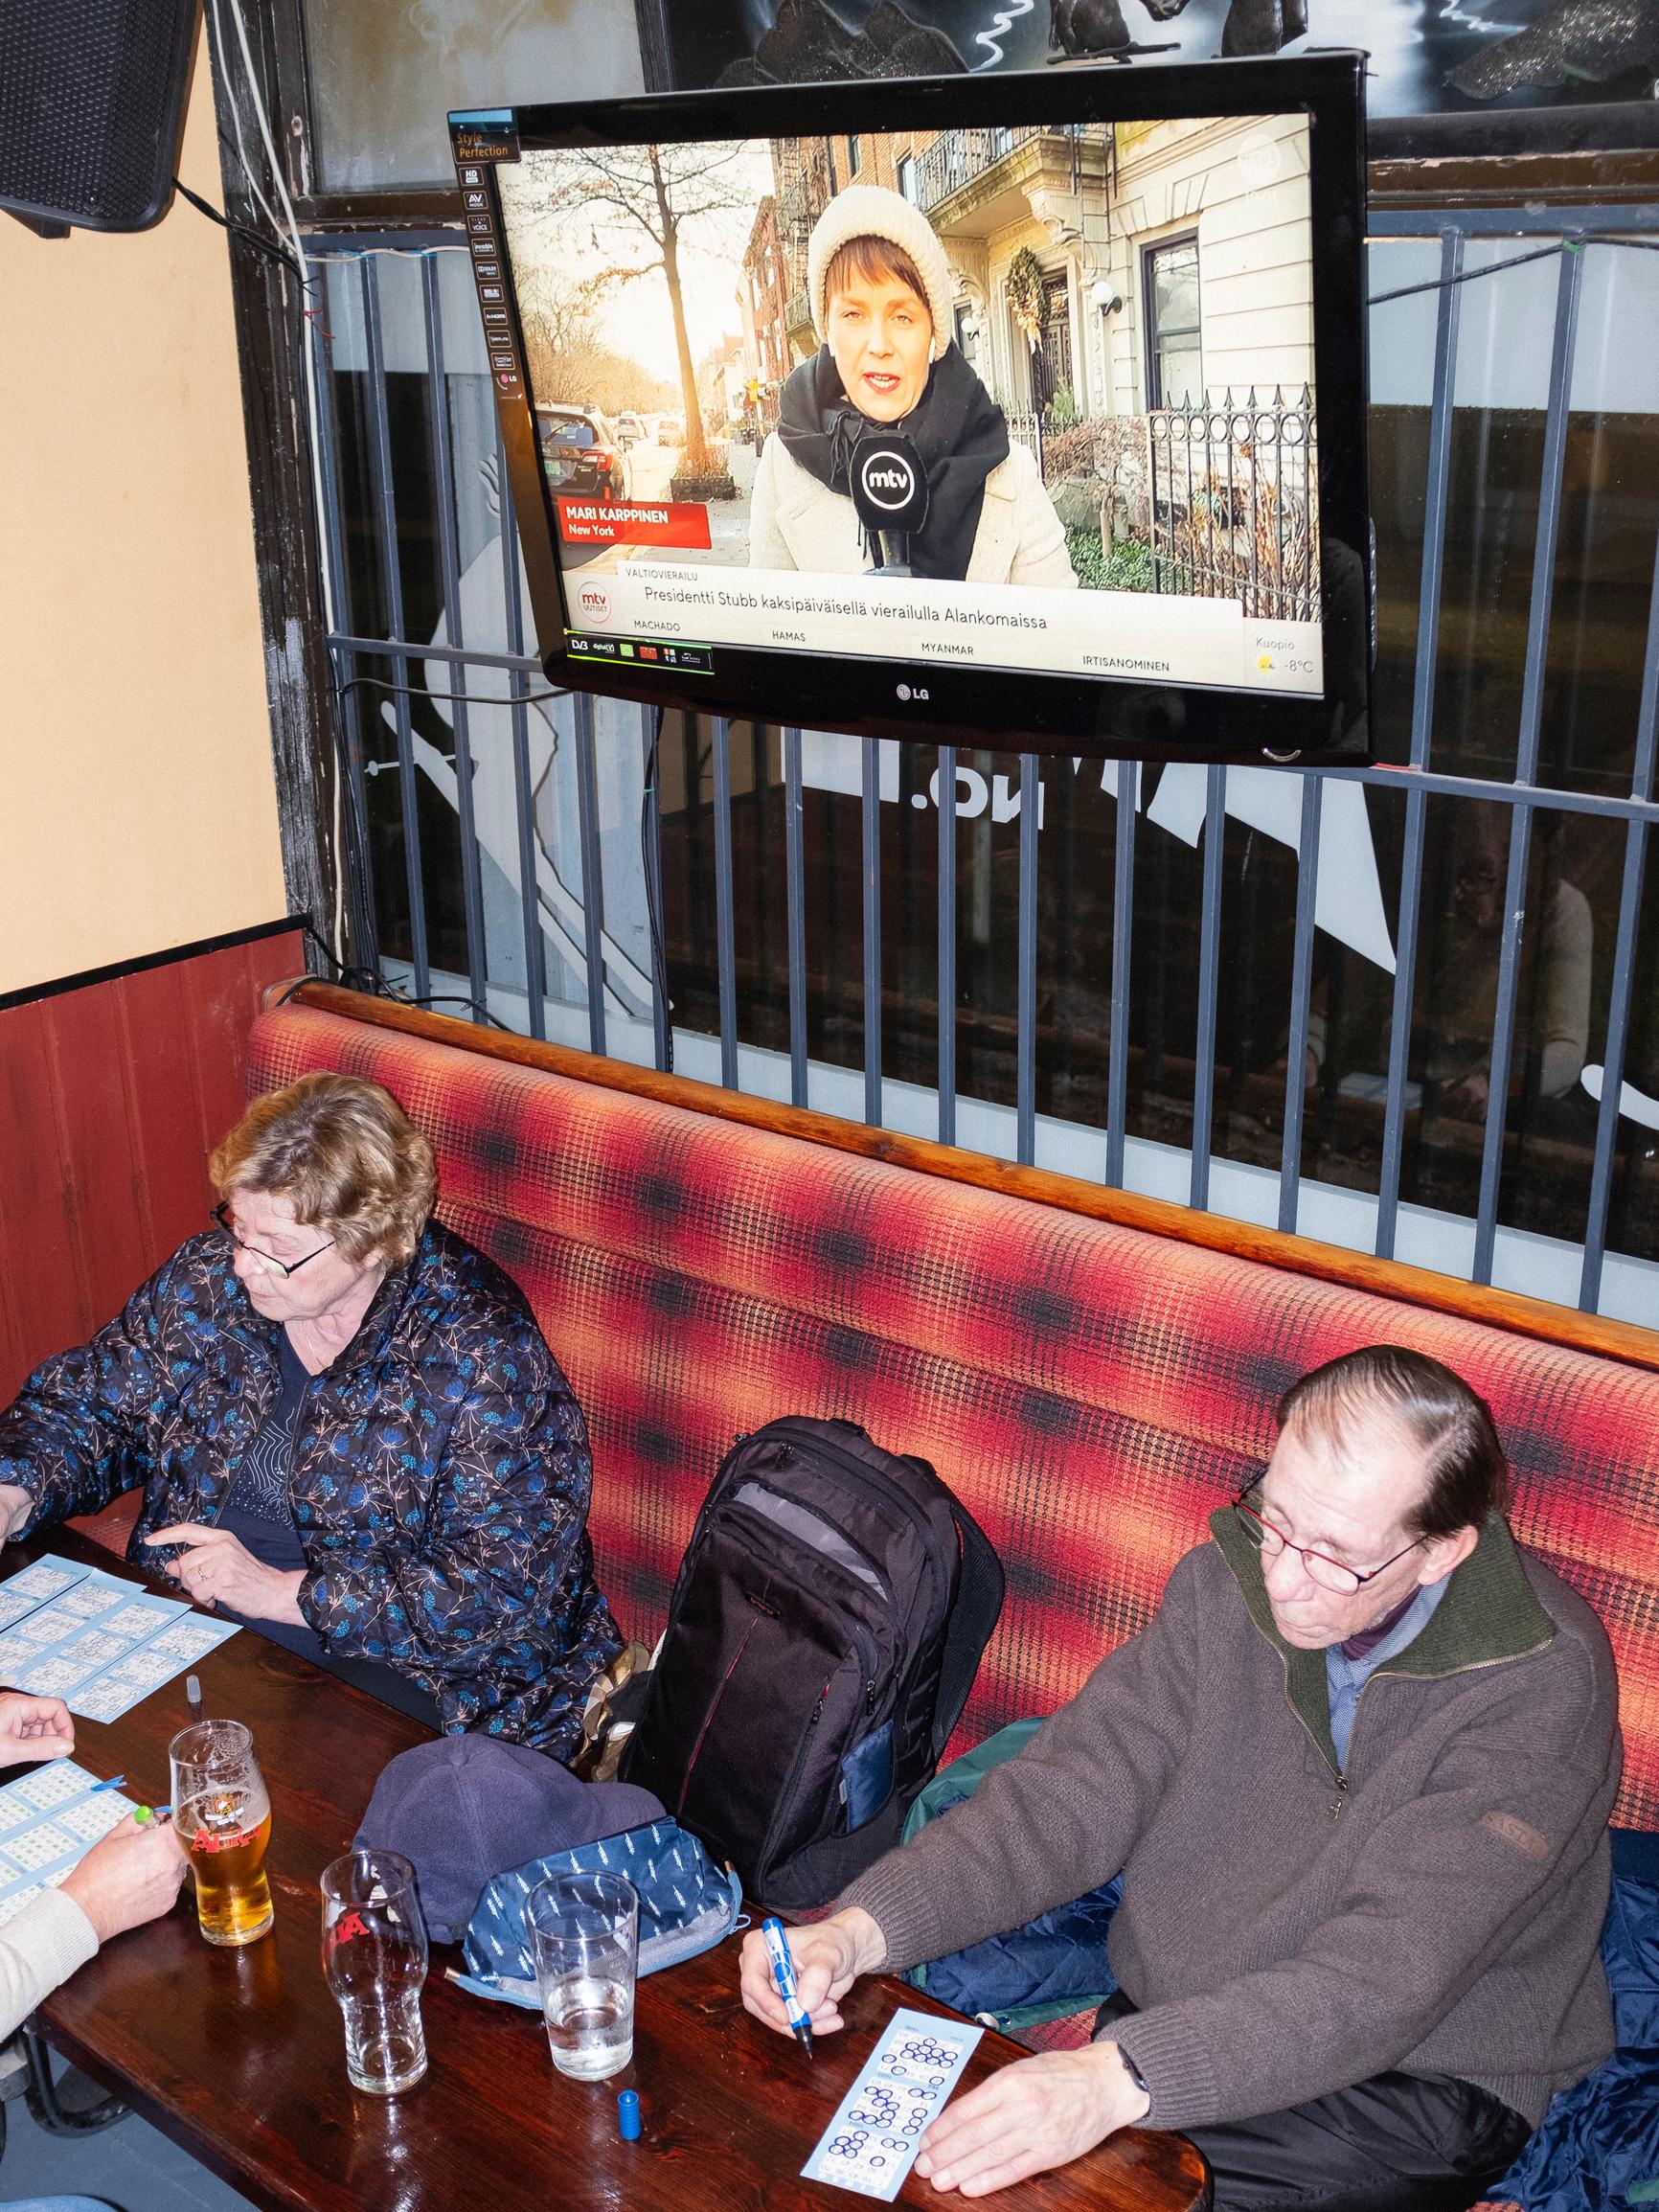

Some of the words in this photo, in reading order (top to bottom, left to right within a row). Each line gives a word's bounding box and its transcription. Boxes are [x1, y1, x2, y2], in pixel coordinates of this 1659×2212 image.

[457, 131, 483, 146] Style
[460, 146, 509, 158] Perfection
[469, 194, 482, 202] AV
[869, 468, 908, 489] mtv
[566, 506, 597, 520] MARI
[599, 508, 669, 524] KARPPINEN
[569, 524, 590, 536] New
[592, 524, 615, 536] York
[625, 568, 698, 582] VALTIOVIERAILU
[582, 592, 606, 604] mtv
[583, 604, 607, 613] UUTISET
[645, 586, 715, 605] Presidentti
[718, 592, 758, 608] Stubb
[761, 594, 867, 616] kaksipäiväisellä
[872, 604, 940, 622] vierailulla
[944, 607, 1048, 629] Alankomaissa
[633, 620, 681, 632] MACHADO
[772, 630, 807, 642] HAMAS
[571, 639, 589, 650] DVB
[921, 643, 975, 656] MYANMAR
[1256, 636, 1295, 651] Kuopio
[1082, 655, 1170, 672] IRTISANOMINEN
[1284, 659, 1314, 673] -8°C
[913, 688, 929, 700] LG
